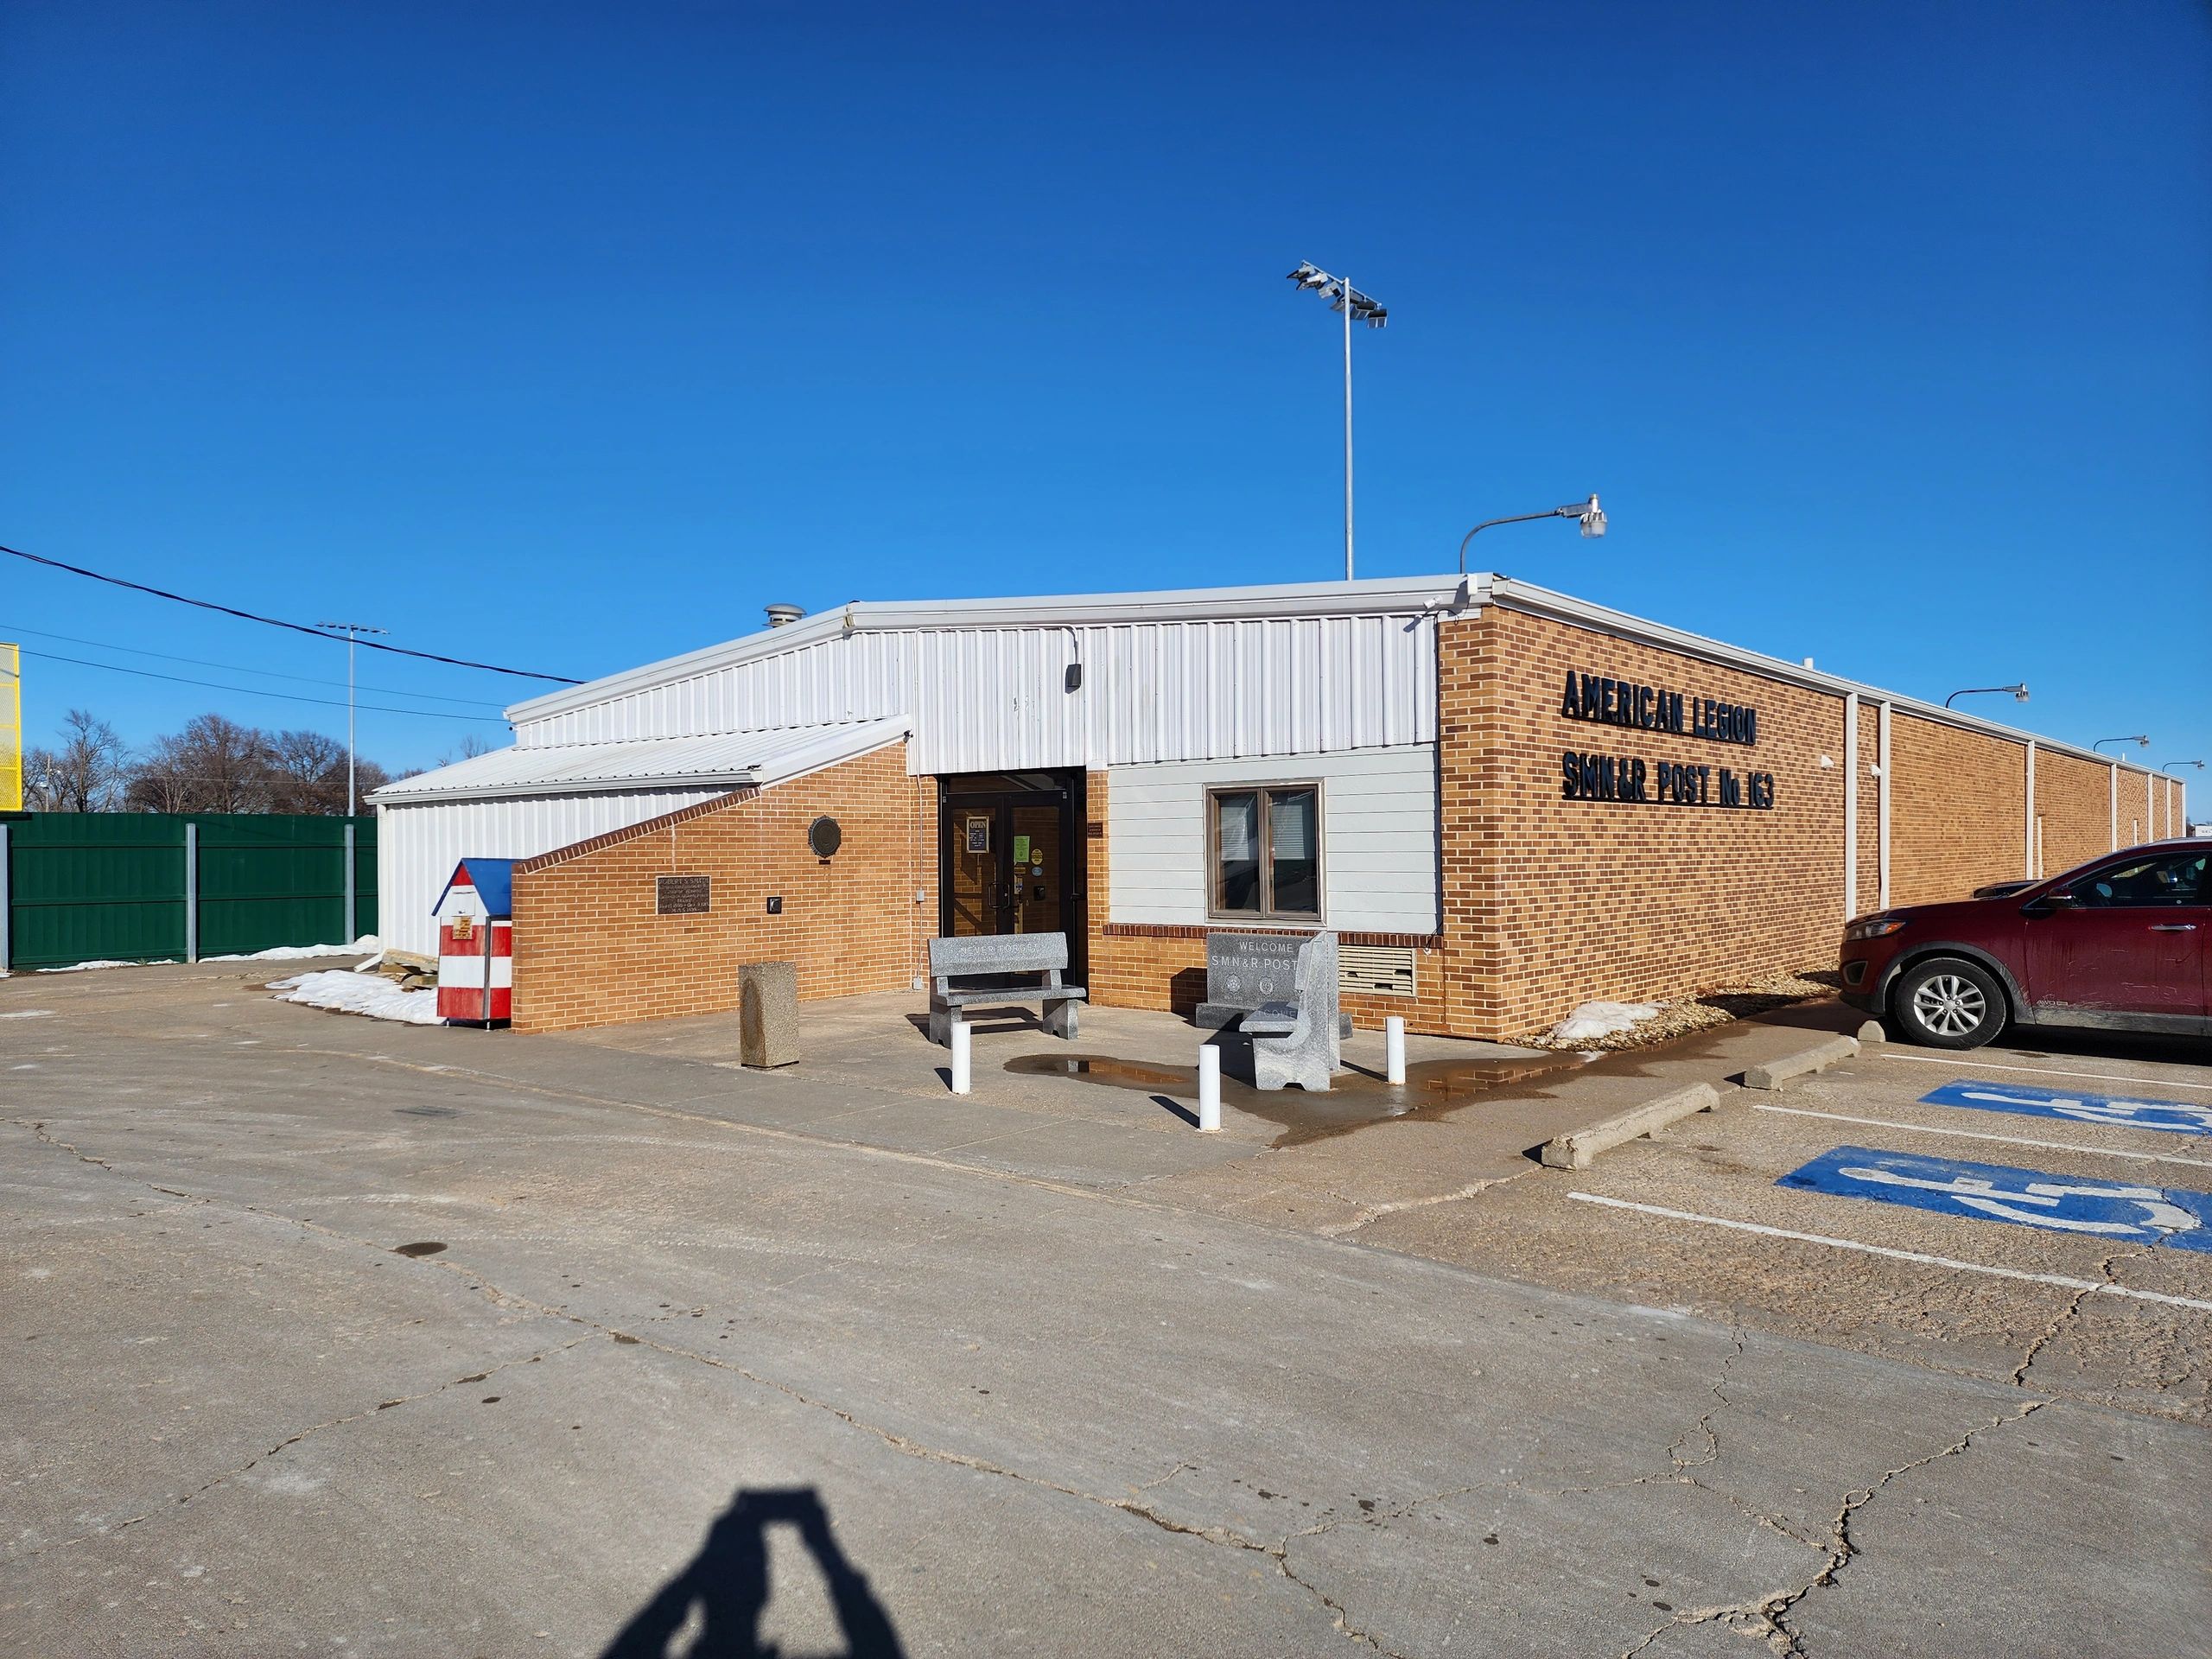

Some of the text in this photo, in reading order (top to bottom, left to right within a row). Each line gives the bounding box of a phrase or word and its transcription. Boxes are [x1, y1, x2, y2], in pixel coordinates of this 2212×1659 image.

[1561, 670, 1757, 744] AMERICAN LEGION
[1562, 751, 1647, 802] SMN&R
[1657, 761, 1710, 804] POST
[1748, 772, 1774, 807] 163
[961, 943, 1038, 955] NEVER FORGET
[1239, 941, 1294, 953] WELCOME
[1211, 955, 1298, 971] SMN&R POST
